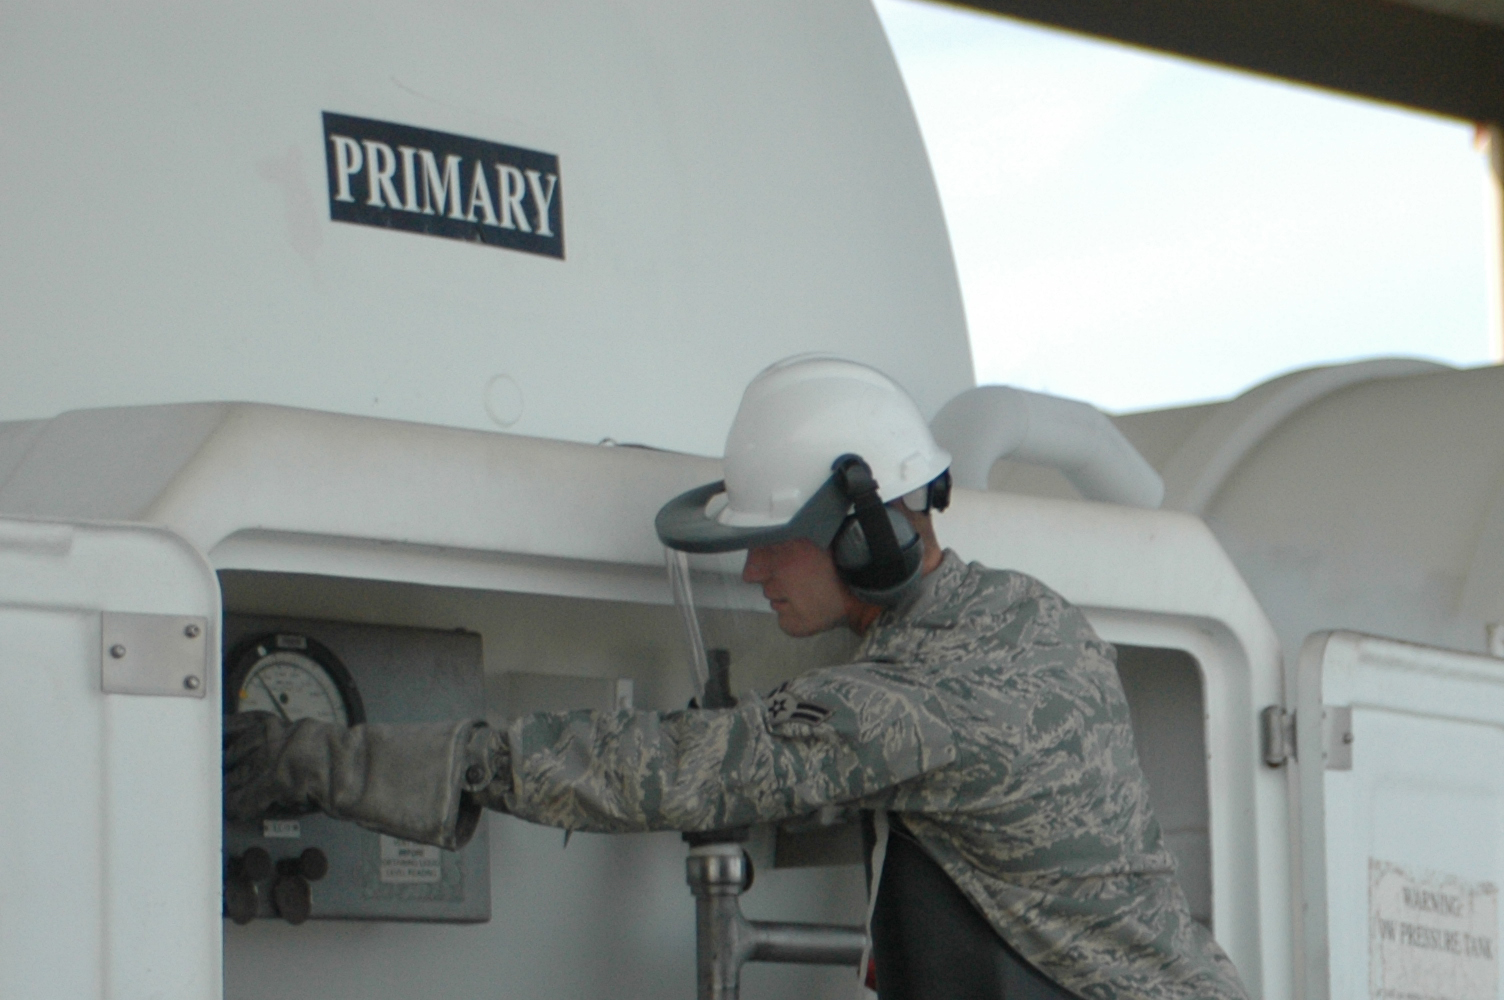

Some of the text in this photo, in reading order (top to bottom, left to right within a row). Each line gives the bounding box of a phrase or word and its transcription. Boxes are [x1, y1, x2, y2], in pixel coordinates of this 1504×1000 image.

[330, 133, 558, 238] PRIMARY
[1400, 921, 1462, 955] PRESSURE
[1463, 931, 1493, 960] TANK
